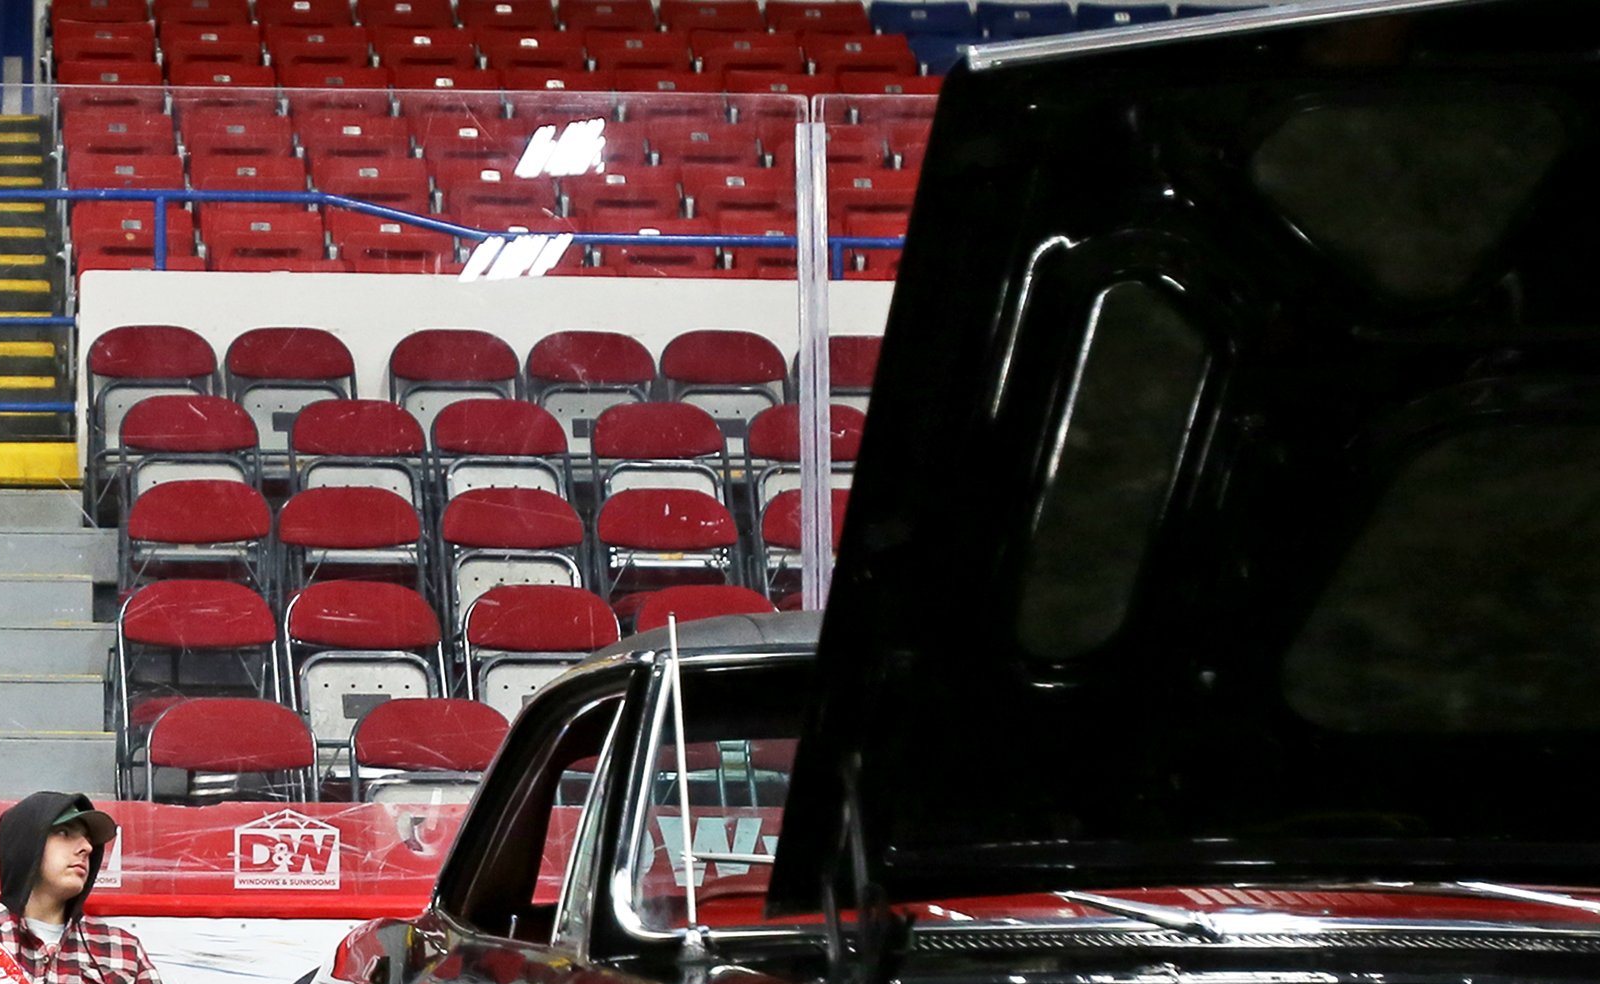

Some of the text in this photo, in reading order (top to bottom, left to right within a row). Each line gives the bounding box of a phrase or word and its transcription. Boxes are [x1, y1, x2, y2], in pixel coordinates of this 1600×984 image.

[240, 833, 336, 875] D&W
[238, 878, 336, 887] WINDOWS & SUNROOMS
